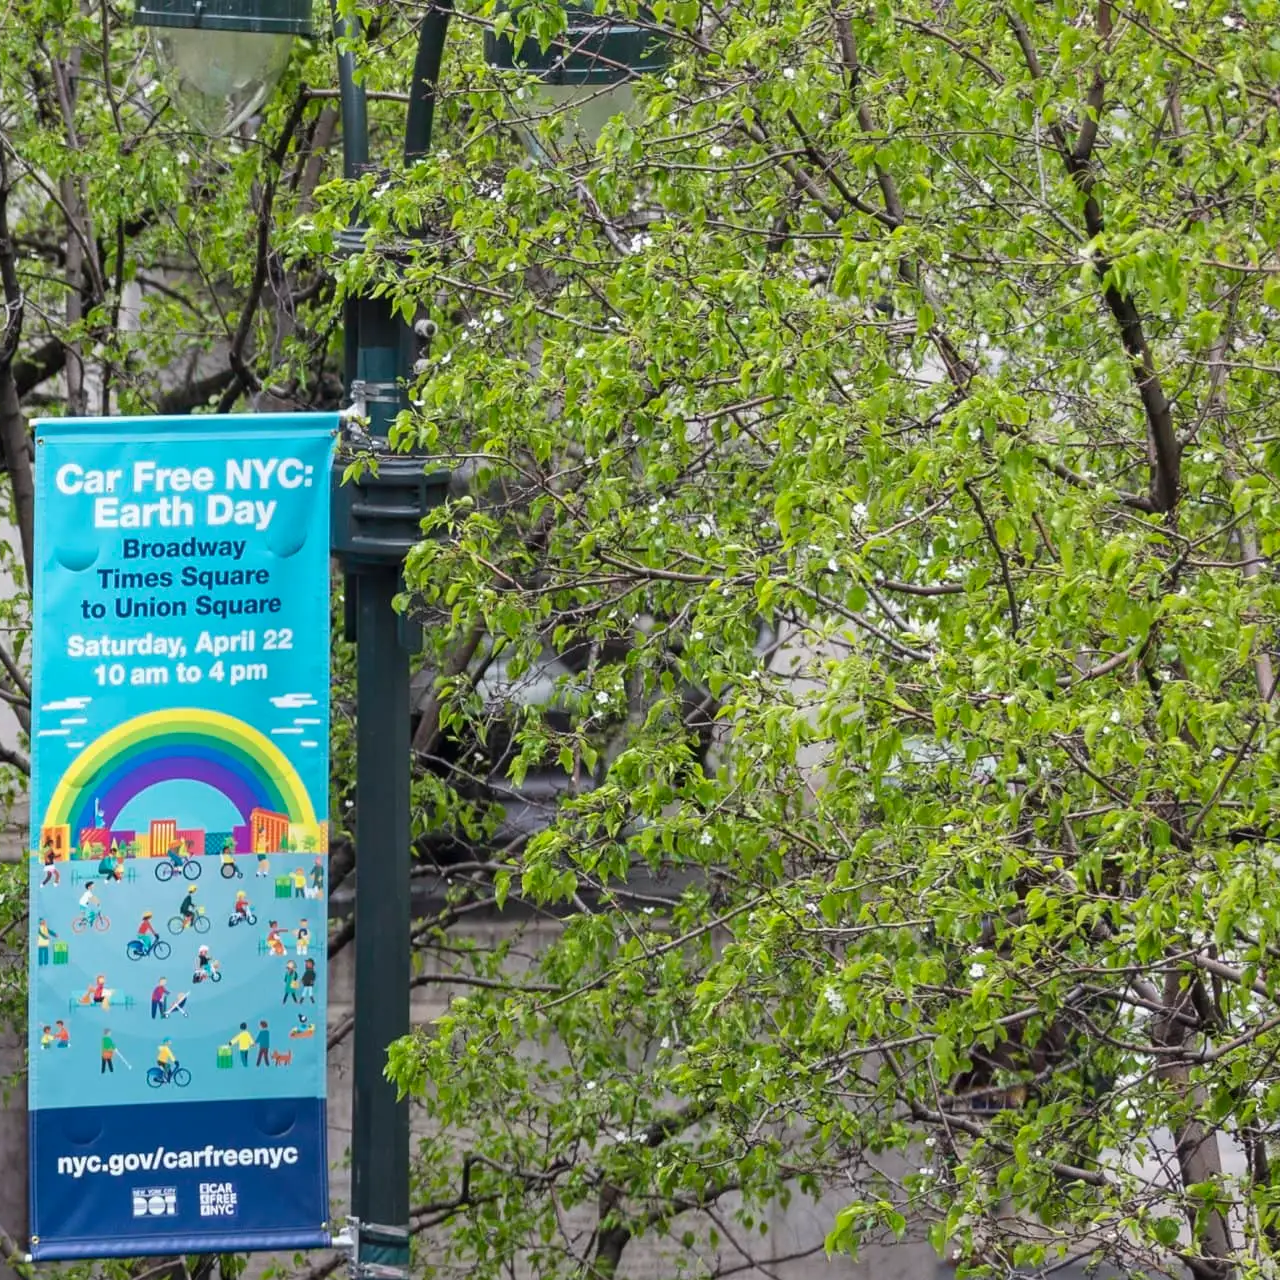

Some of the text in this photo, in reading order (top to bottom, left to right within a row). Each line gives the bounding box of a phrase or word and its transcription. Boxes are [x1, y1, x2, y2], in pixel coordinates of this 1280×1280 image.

[56, 457, 314, 495] Car Free NYC:
[94, 496, 277, 531] Earth Day
[123, 535, 247, 561] Broadway
[97, 565, 270, 591] Times Square
[81, 595, 282, 620] to Union Square
[67, 629, 294, 658] Saturday, April 22
[94, 662, 268, 687] 10 am to 4 pm
[57, 1145, 299, 1178] nyc.gov/carfreenyc
[209, 1183, 233, 1194] CAR
[210, 1193, 237, 1205] FREE
[133, 1196, 177, 1216] DOT
[210, 1204, 235, 1216] NYC
